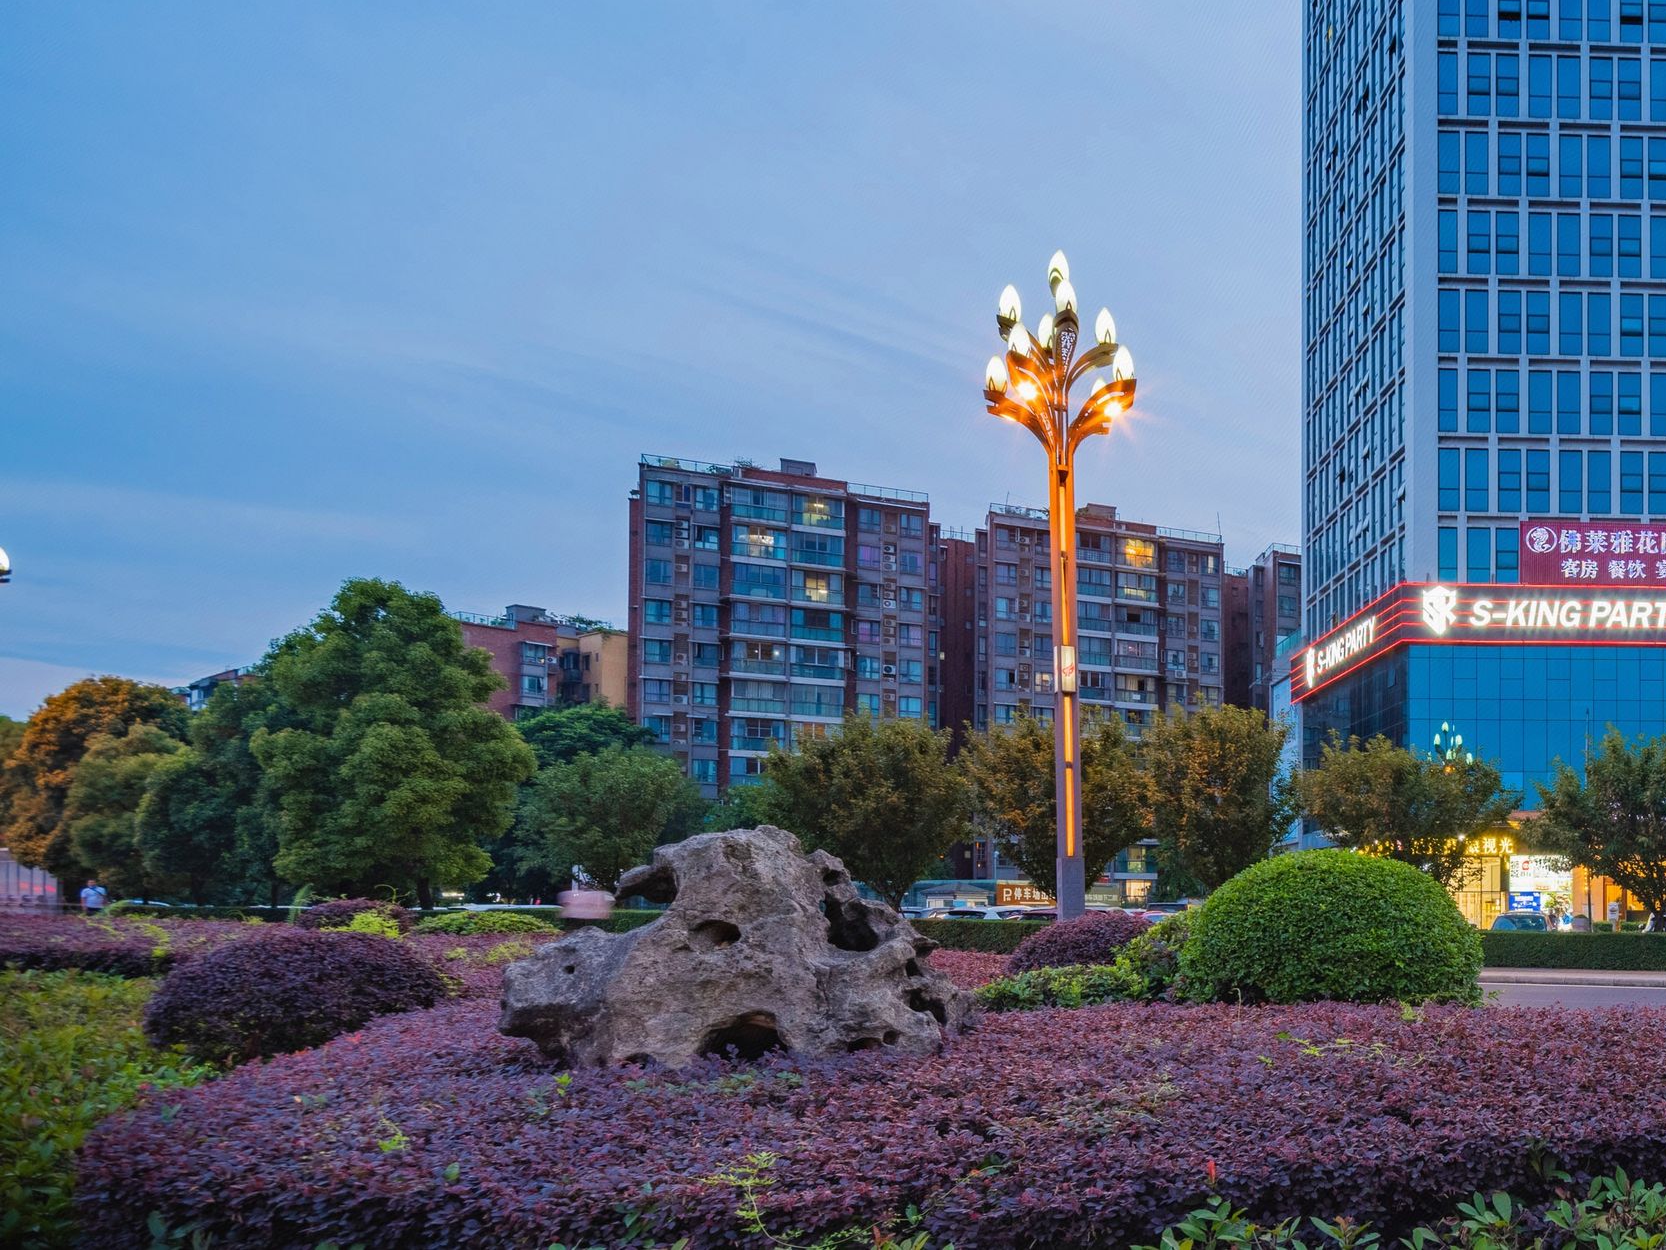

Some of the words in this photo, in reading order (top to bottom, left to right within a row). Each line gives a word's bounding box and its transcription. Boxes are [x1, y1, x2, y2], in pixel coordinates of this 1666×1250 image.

[1561, 558, 1599, 579] 客房
[1608, 559, 1647, 579] 餐饮
[1469, 600, 1581, 627] S-KING
[1317, 637, 1345, 674] S-KING
[1344, 615, 1376, 658] PARTY
